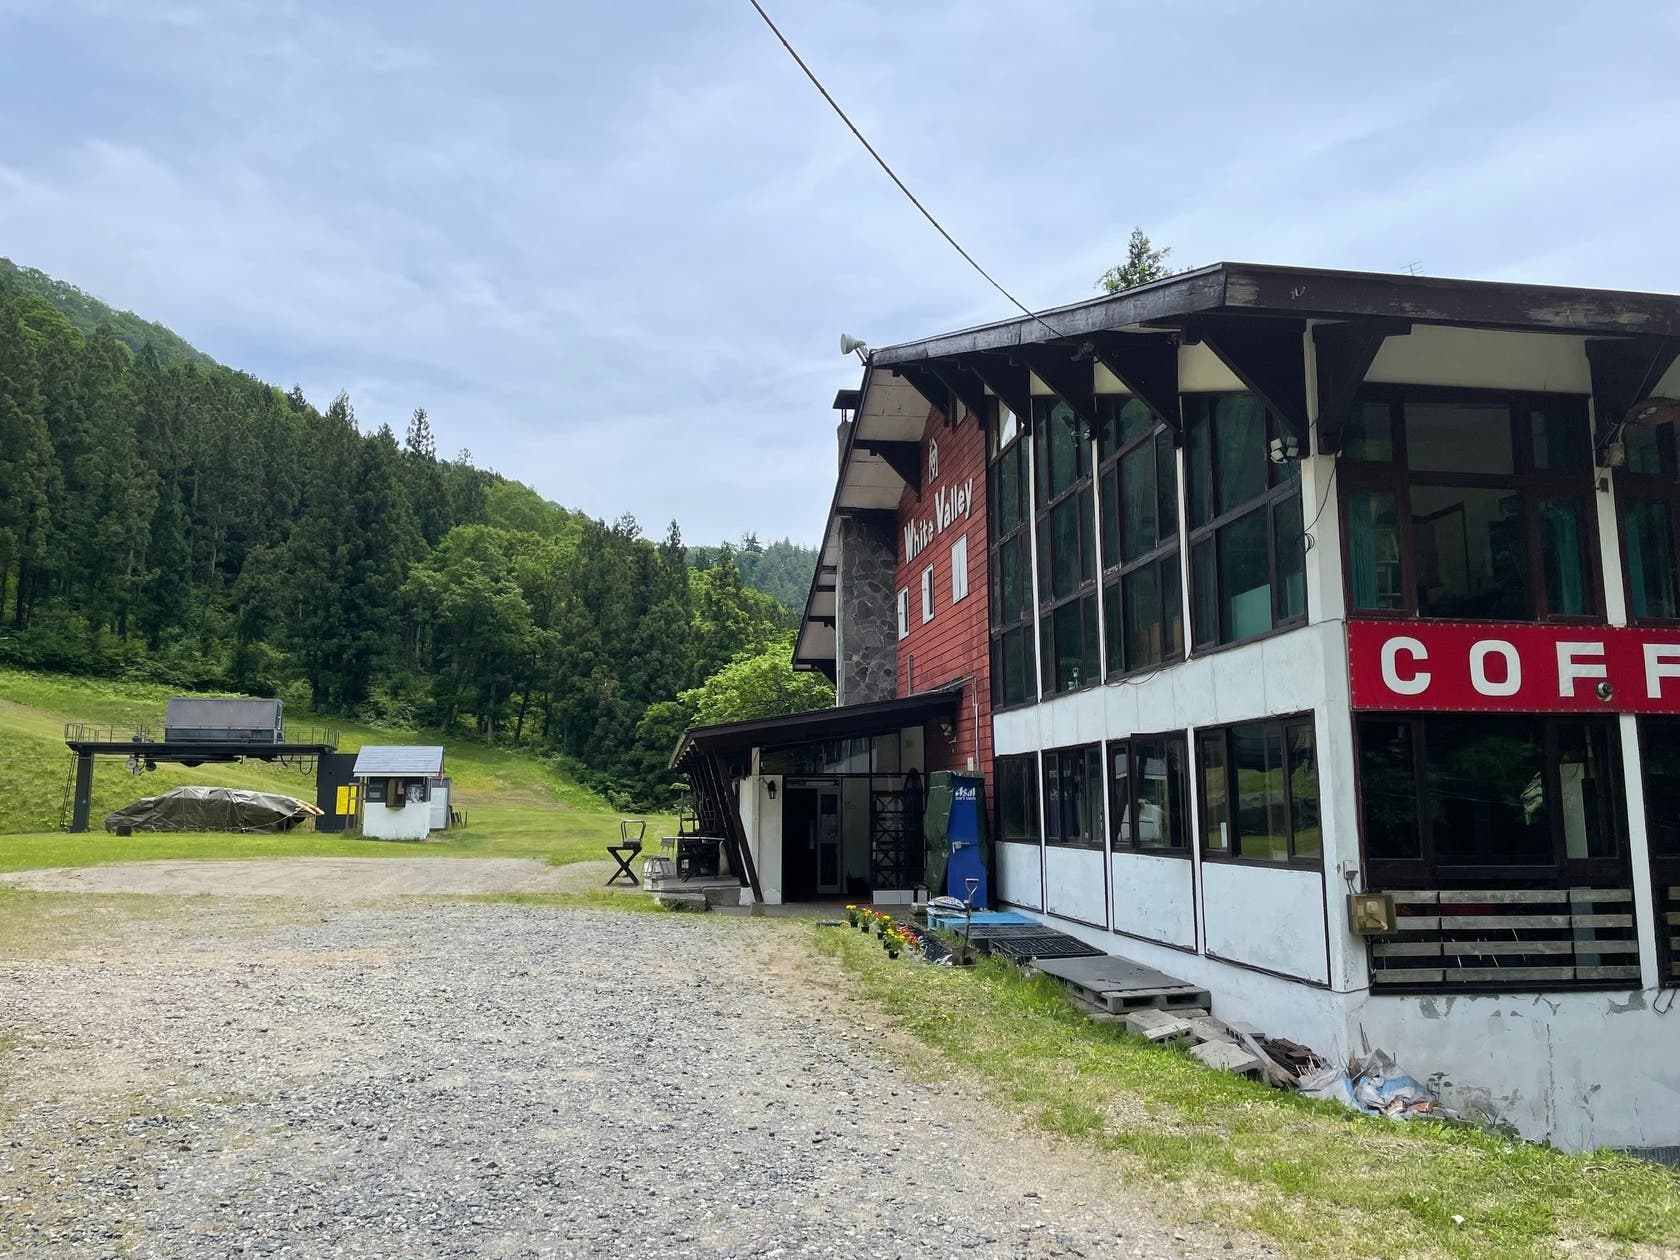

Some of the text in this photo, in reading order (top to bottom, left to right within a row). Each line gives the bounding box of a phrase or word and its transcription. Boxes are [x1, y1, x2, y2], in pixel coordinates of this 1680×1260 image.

[904, 477, 974, 565] White Valley
[1380, 636, 1680, 698] COFF
